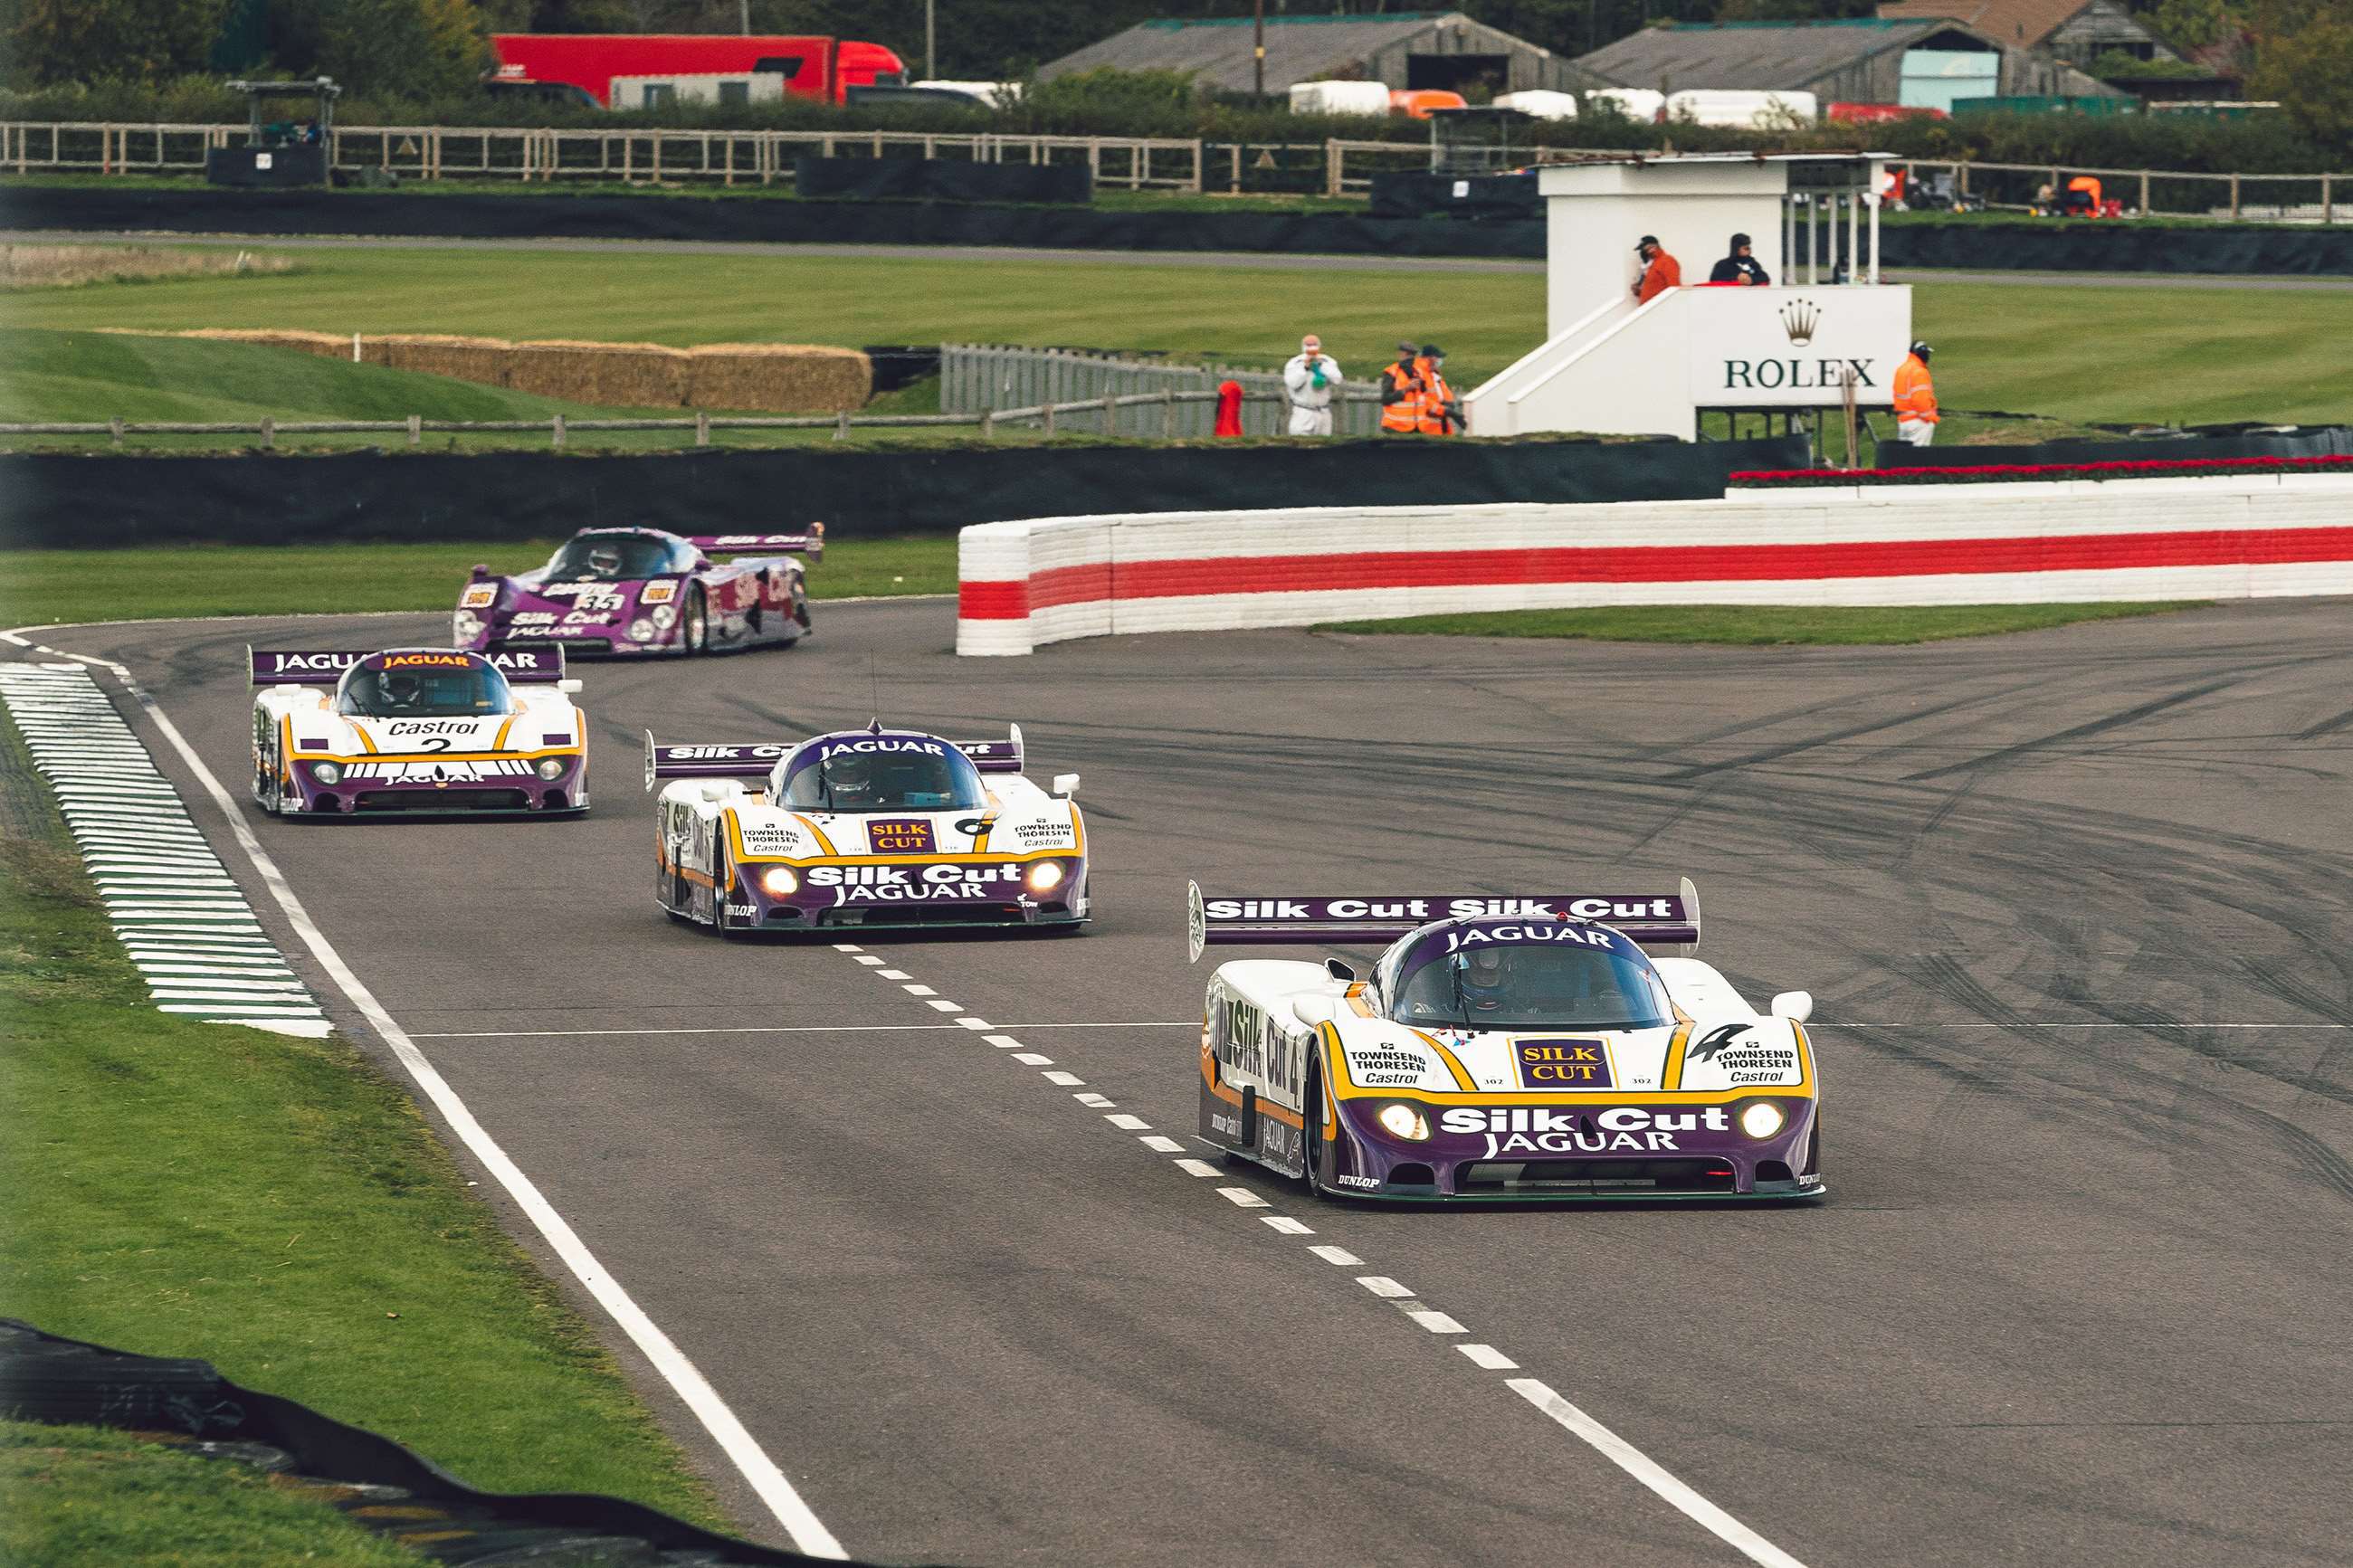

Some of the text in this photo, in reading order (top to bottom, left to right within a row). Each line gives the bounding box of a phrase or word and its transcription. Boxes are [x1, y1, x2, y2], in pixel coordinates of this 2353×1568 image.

[1724, 358, 1878, 388] ROLEX
[274, 654, 369, 672] JAGU
[384, 654, 470, 669] JAGUAR
[388, 721, 480, 736] Castrol
[421, 737, 452, 753] 2
[819, 740, 945, 762] JAGUAR
[960, 744, 992, 755] ut
[668, 746, 741, 759] Silk
[385, 774, 485, 786] JAGUAR
[743, 830, 800, 839] TOWNSEND
[872, 824, 929, 836] SILK
[1015, 823, 1072, 833] TOWNSEND
[1018, 830, 1071, 838] THORESEN
[747, 836, 799, 844] THORESEN
[878, 837, 927, 849] CUT
[1024, 838, 1063, 848] Castrol
[753, 844, 794, 852] Castrol
[807, 863, 1022, 887] Silk Cut
[833, 883, 987, 908] JAGUAR
[1205, 898, 1672, 918] Silk Cut Silk Cut
[1445, 926, 1615, 954] JAGUAR
[1687, 1023, 1754, 1063] 4
[1267, 1019, 1287, 1090] Cut
[1350, 1051, 1426, 1066] TOWNSEND
[1524, 1047, 1599, 1061] SILK
[1716, 1050, 1794, 1063] TOWNSEND
[1355, 1060, 1426, 1073] THORESEN
[1720, 1059, 1793, 1069] THORESEN
[1365, 1072, 1418, 1084] Castrol
[1532, 1065, 1596, 1080] CUT
[1730, 1071, 1784, 1082] Castrol
[1440, 1107, 1729, 1134] Silk Cut
[1482, 1132, 1680, 1160] JAGUAR
[1338, 1174, 1381, 1188] DUNLOP
